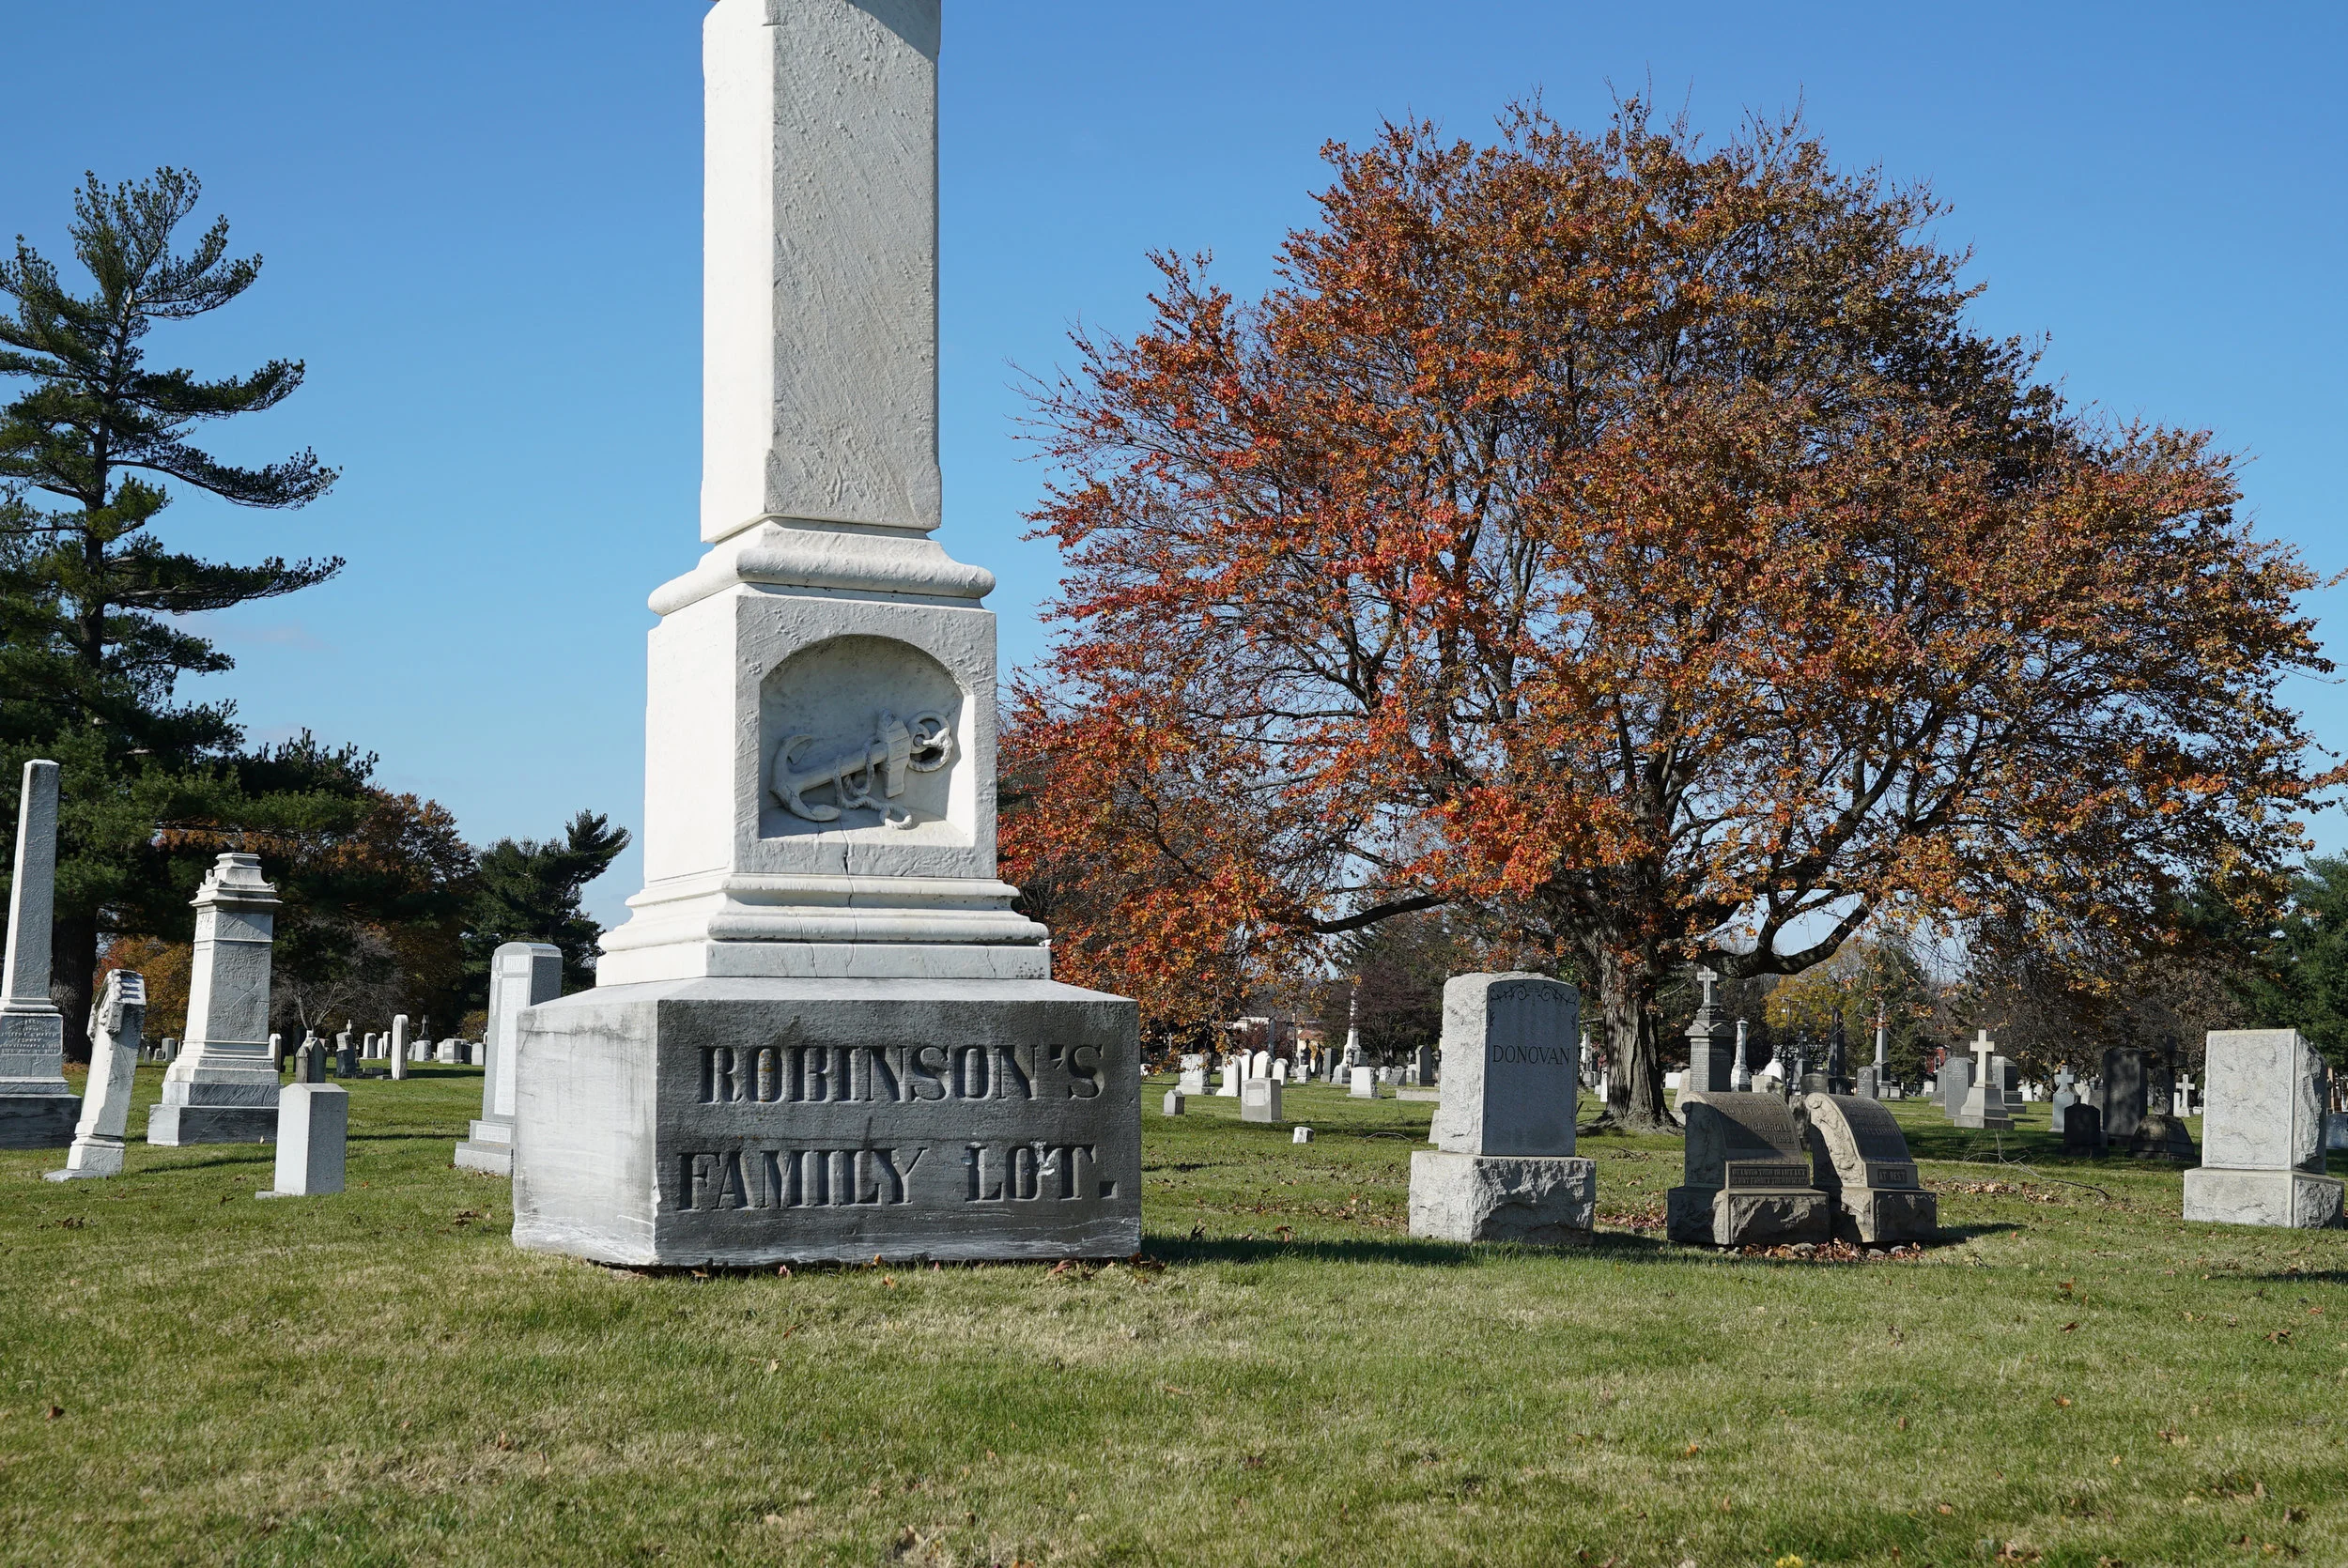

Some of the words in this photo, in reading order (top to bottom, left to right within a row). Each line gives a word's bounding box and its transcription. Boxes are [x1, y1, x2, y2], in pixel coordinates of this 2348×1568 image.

[698, 1044, 1105, 1104] ROBINSON'S
[1492, 1044, 1570, 1066] DONOVAN
[676, 1147, 929, 1211] FAMILY
[965, 1144, 1120, 1204] LOT.
